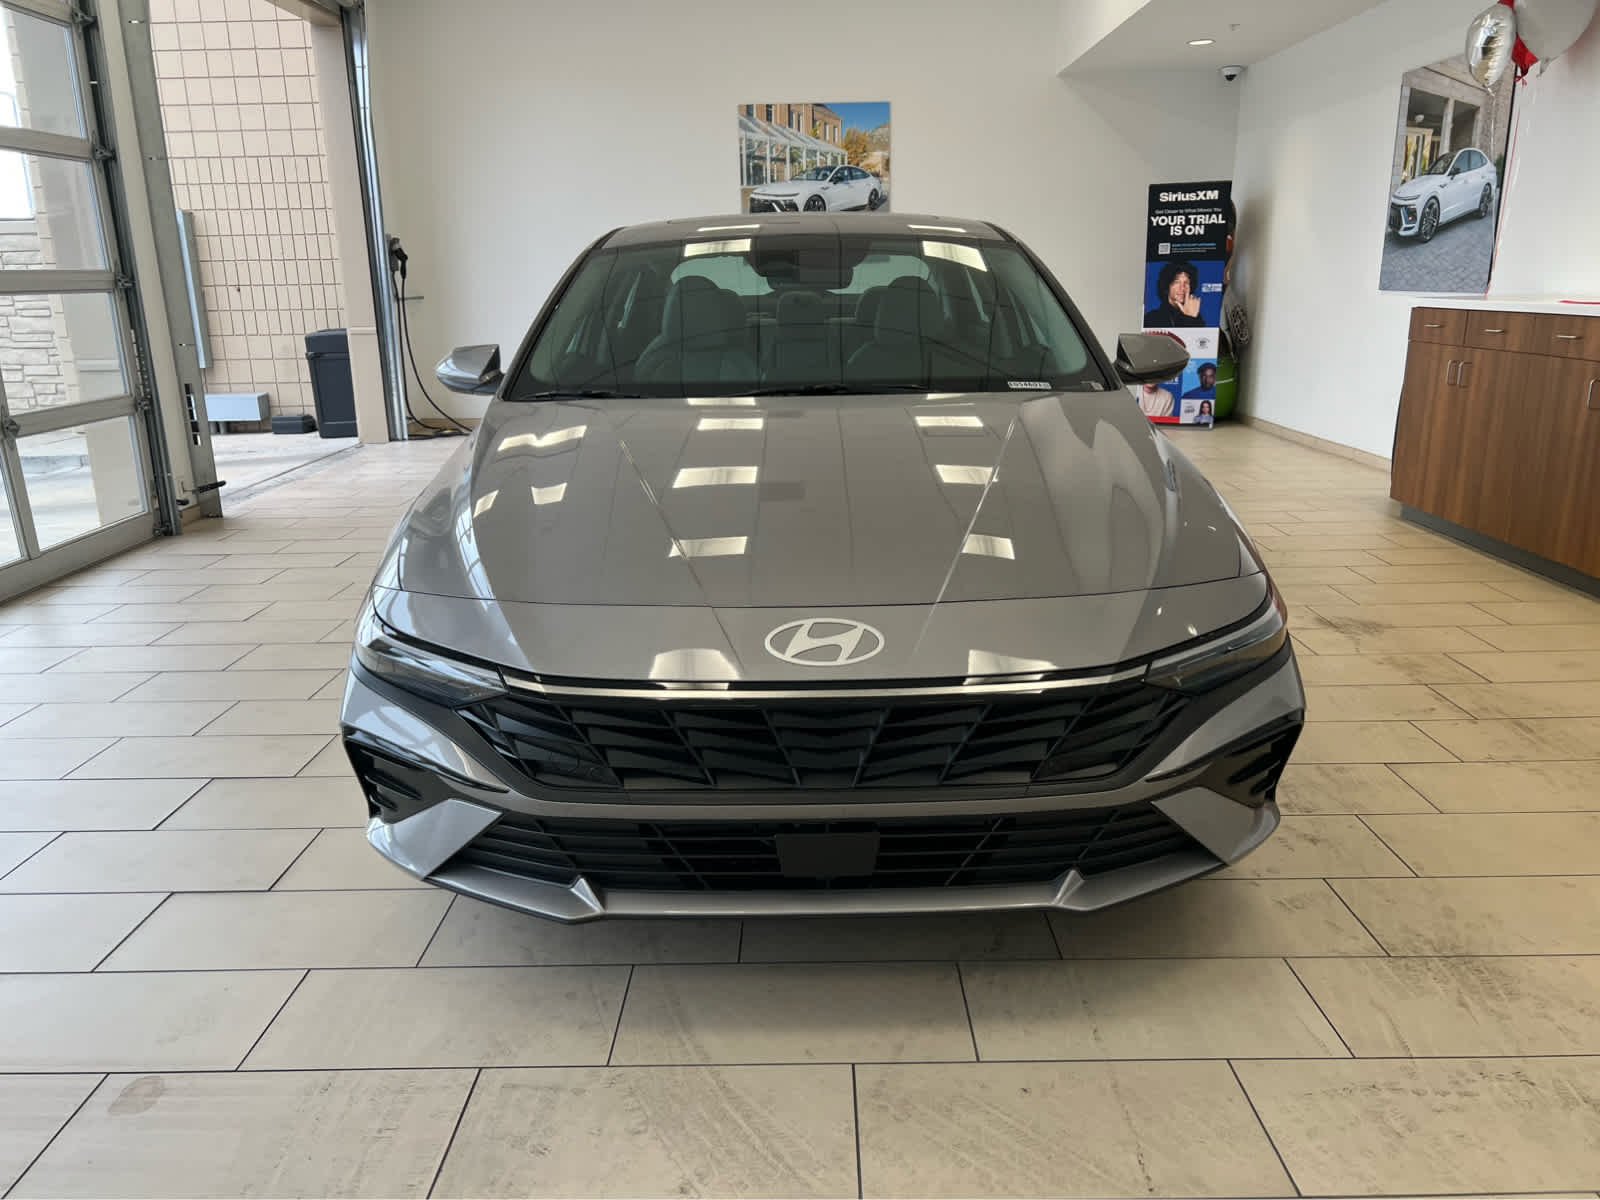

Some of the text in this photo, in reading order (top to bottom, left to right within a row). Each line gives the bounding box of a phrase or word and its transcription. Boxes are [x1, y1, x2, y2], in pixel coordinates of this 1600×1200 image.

[1159, 190, 1219, 202] SiriusXM
[1150, 214, 1226, 226] YOUR TRIAL
[1170, 225, 1205, 236] IS ON
